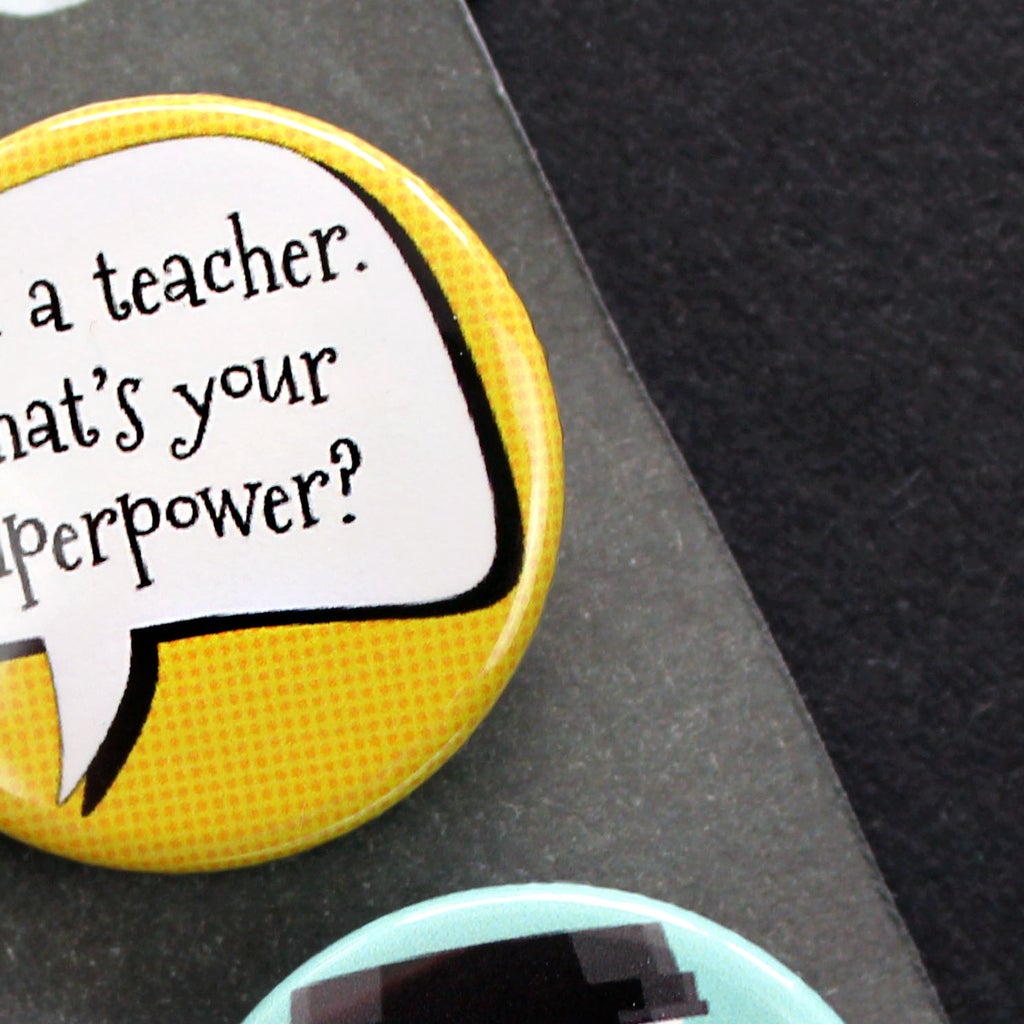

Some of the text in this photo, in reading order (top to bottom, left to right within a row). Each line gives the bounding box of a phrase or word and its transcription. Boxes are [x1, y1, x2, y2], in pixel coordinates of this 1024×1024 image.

[28, 278, 73, 332] a
[92, 212, 369, 321] teacher.
[170, 345, 337, 460] your
